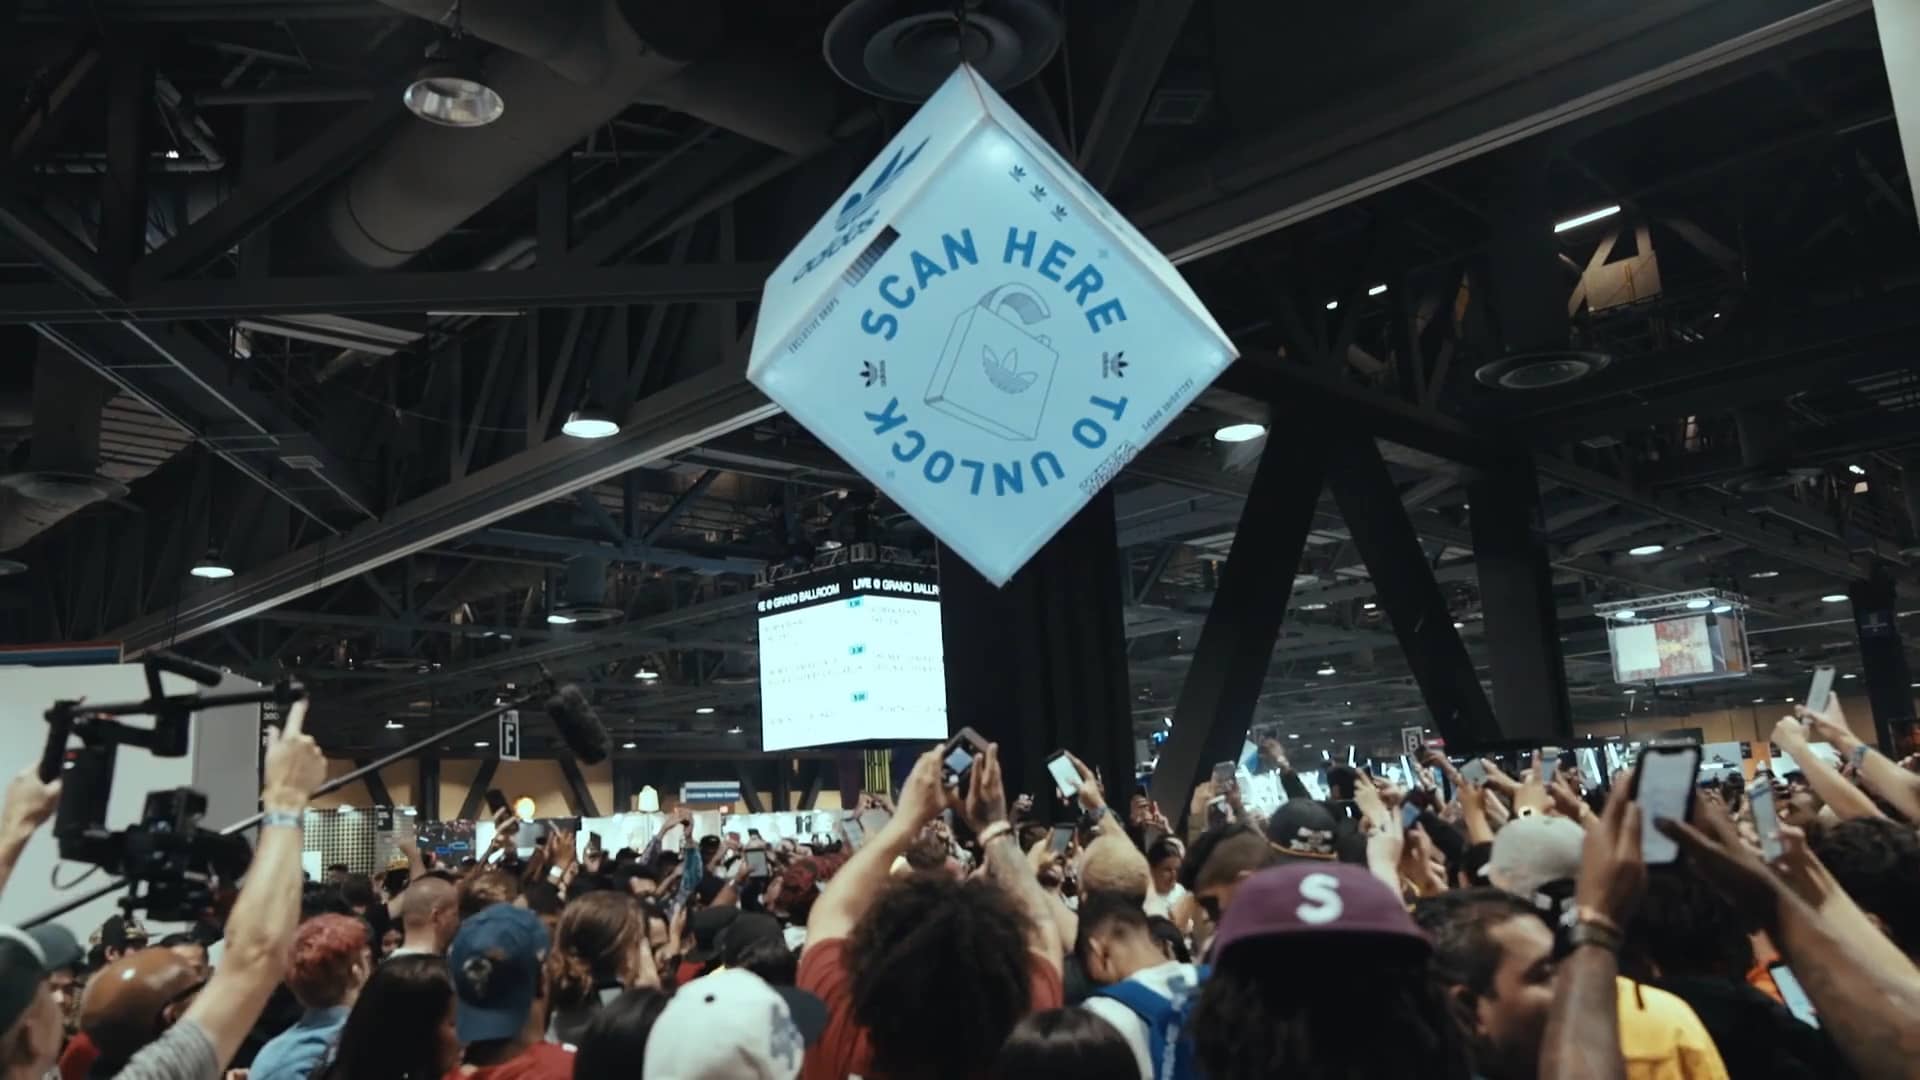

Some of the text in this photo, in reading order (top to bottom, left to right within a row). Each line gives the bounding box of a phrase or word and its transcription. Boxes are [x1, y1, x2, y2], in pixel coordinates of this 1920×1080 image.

[861, 227, 978, 341] SCAN
[1003, 226, 1127, 334] HERE
[864, 398, 1066, 497] UNLOCK
[1071, 394, 1129, 450] TO
[773, 593, 798, 609] GRAND
[799, 583, 840, 603] BALLROOM
[852, 577, 873, 591] LIVE
[881, 579, 912, 593] GRAND
[1296, 872, 1343, 925] S
